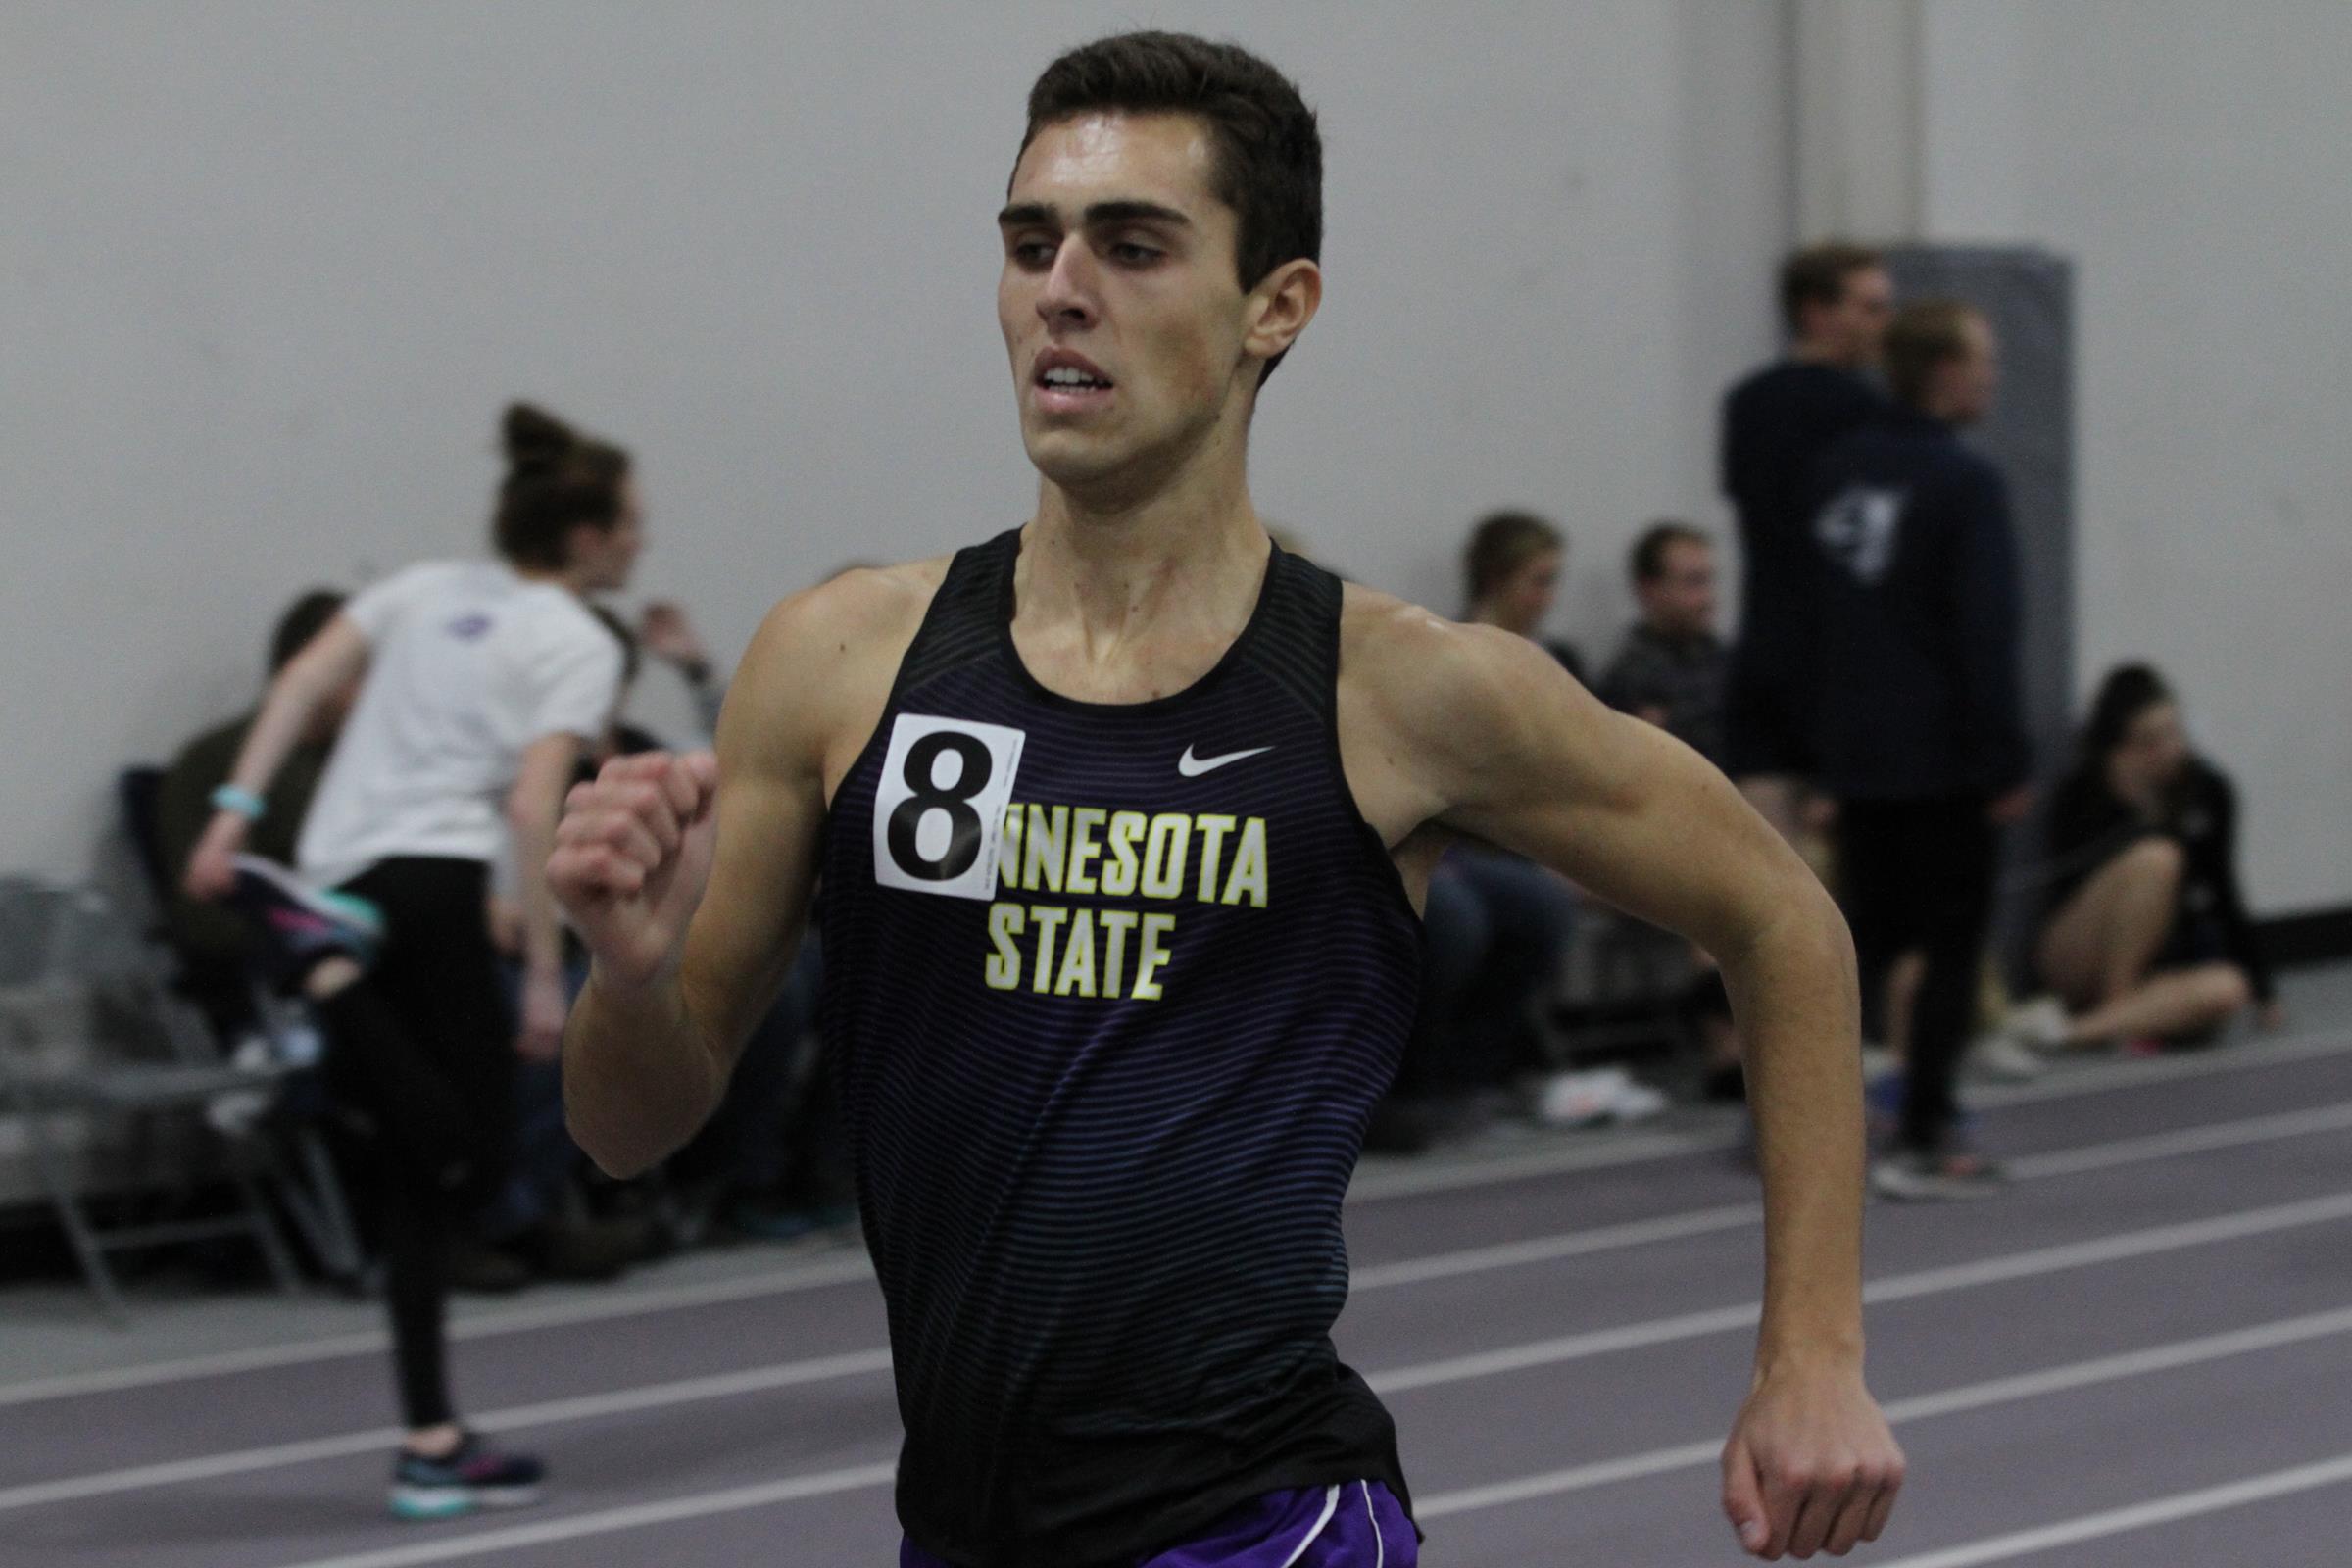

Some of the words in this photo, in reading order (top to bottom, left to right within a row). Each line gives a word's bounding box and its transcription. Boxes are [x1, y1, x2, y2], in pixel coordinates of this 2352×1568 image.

[887, 730, 993, 881] 8
[998, 803, 1268, 908] NNESOTA
[985, 902, 1175, 1001] STATE
